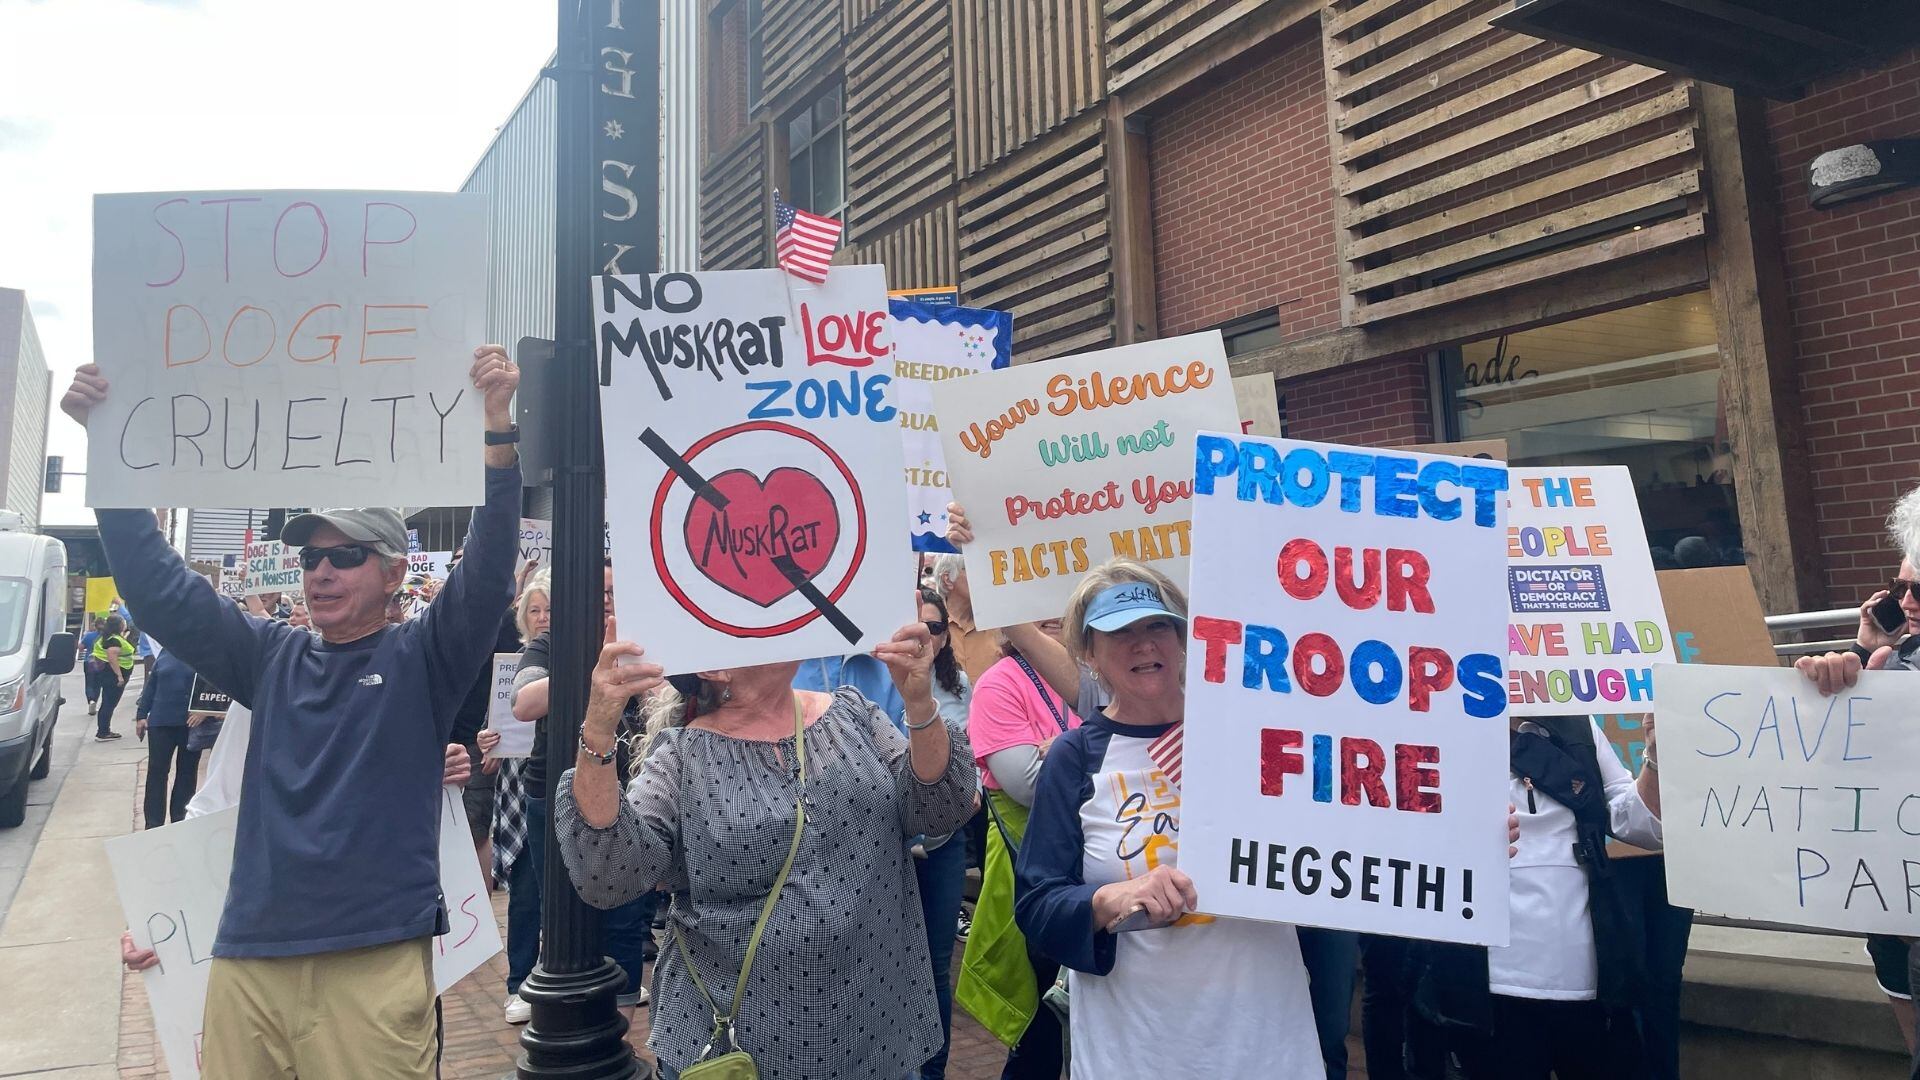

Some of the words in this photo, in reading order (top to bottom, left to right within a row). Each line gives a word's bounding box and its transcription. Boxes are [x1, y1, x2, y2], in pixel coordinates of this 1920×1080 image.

[146, 197, 416, 287] STOP
[602, 272, 702, 313] NO
[165, 303, 429, 369] DOGE
[895, 360, 979, 382] REEDO
[745, 371, 897, 423] ZONE
[959, 398, 1040, 458] Your
[1046, 361, 1214, 416] Silence
[120, 389, 464, 471] CRUELTY
[1039, 431, 1109, 467] Will
[1117, 420, 1175, 456] not
[1005, 481, 1124, 526] Protect
[1194, 434, 1508, 528] PROTECT
[1522, 478, 1596, 507] THE
[248, 544, 269, 558] DOGE
[272, 543, 280, 556] IS
[283, 557, 300, 569] MUS
[989, 537, 1090, 586] FACTS
[1109, 520, 1192, 562] MATT
[1508, 525, 1612, 557] EOPLE
[262, 570, 301, 586] MONSTER
[1277, 538, 1436, 614] OUR
[1515, 570, 1594, 581] DICTATOR
[1519, 592, 1597, 602] DEMOCRACY
[1548, 582, 1565, 591] OR
[1568, 601, 1600, 609] CHOICE
[1508, 622, 1569, 656] AVE
[1581, 621, 1664, 655] HAD
[1193, 616, 1508, 719] TROOPS
[1508, 668, 1653, 703] ENOUGH
[497, 691, 511, 700] DE
[1697, 693, 1872, 762] SAVE
[1261, 728, 1442, 814] FIRE
[1700, 785, 1920, 836] NATIO
[1797, 848, 1920, 914] PAR
[147, 910, 215, 975] PL
